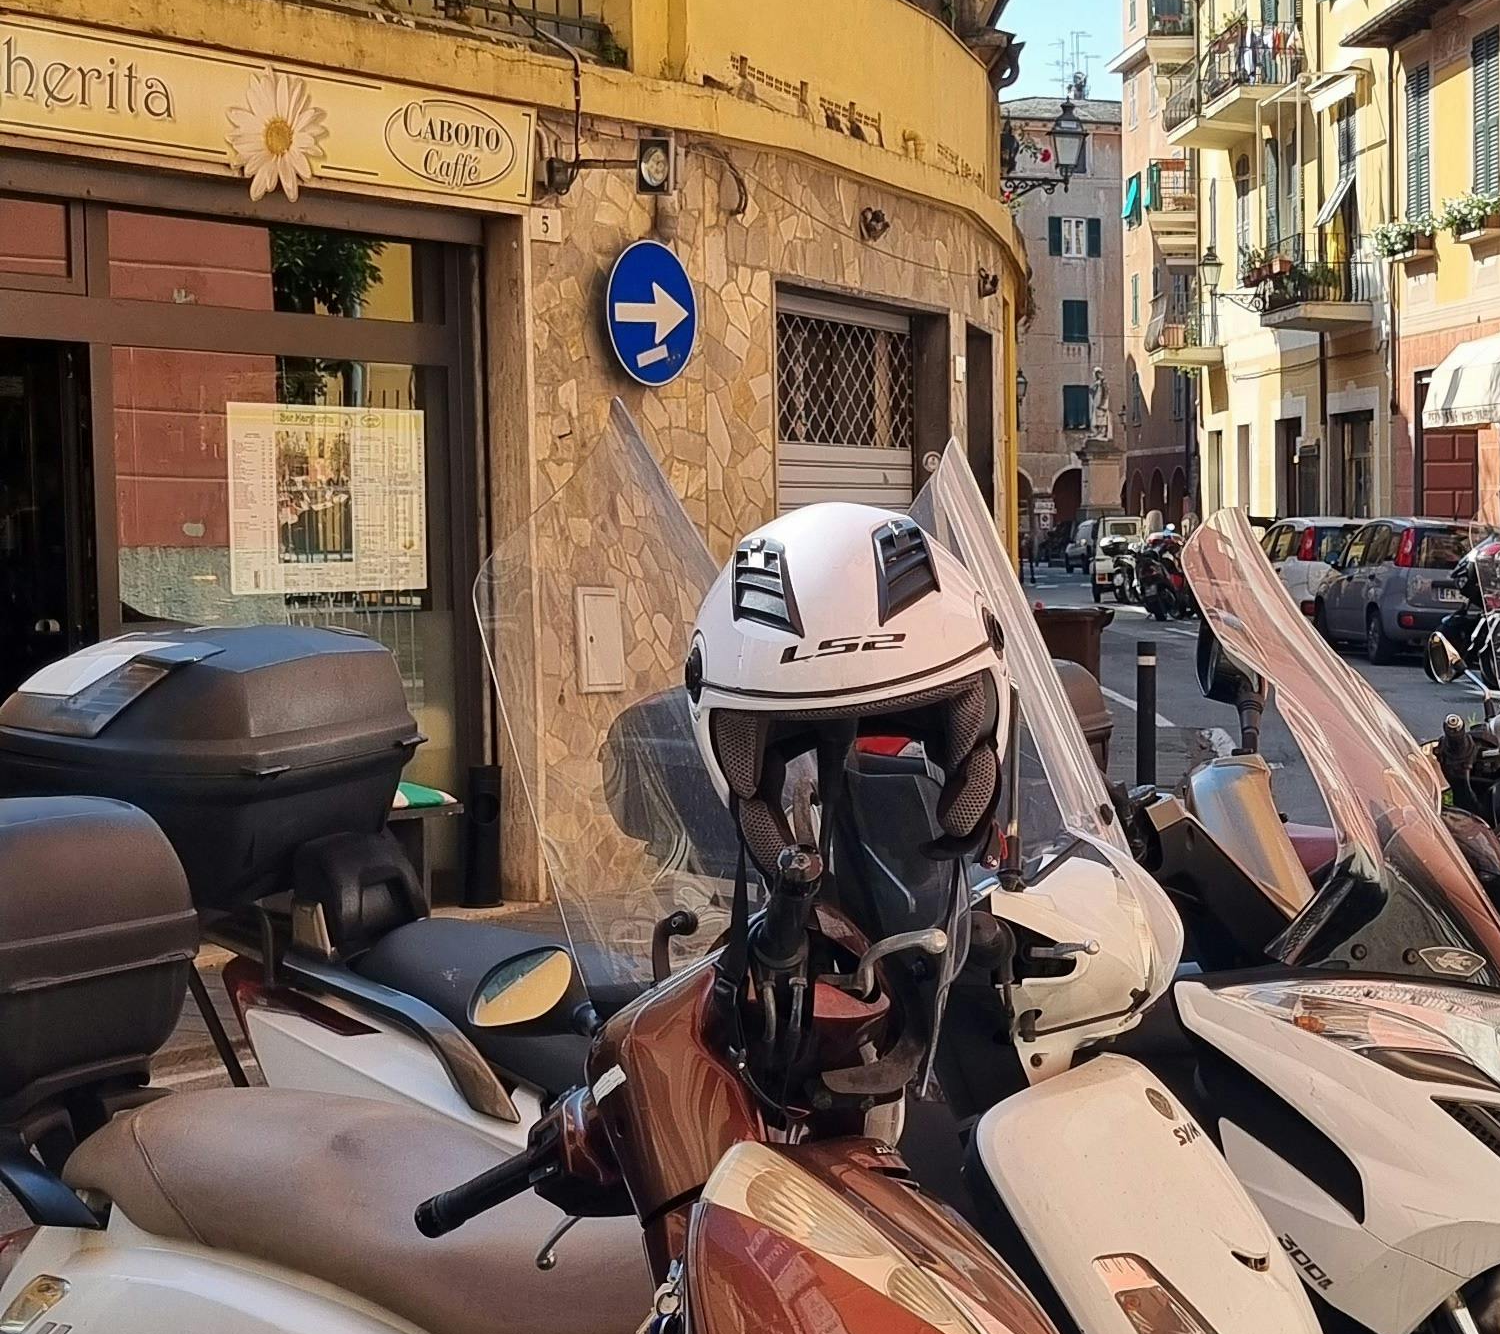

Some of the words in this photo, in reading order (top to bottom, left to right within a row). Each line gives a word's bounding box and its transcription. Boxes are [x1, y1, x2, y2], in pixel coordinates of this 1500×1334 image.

[402, 101, 501, 152] CABOTO
[541, 215, 550, 234] 5
[779, 633, 907, 665] LS2
[1172, 1121, 1202, 1147] SYM
